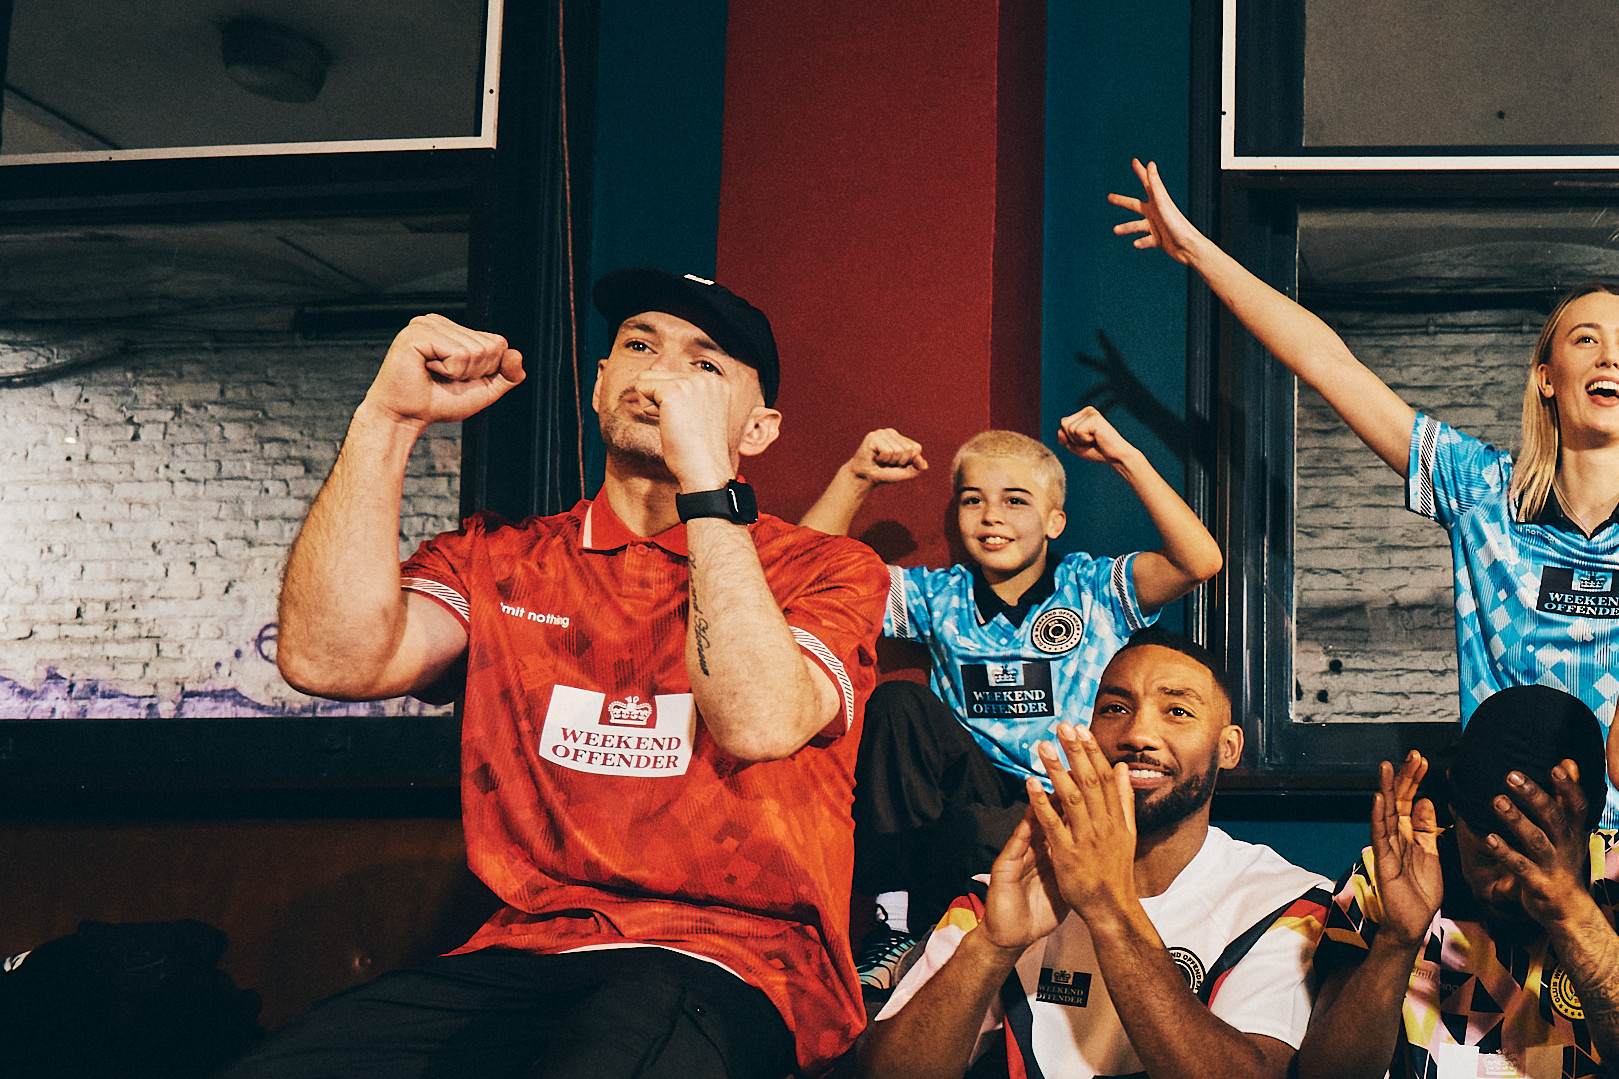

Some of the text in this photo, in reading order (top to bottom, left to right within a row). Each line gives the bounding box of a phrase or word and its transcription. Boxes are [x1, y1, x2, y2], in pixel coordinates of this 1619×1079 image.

[500, 602, 525, 618] mit
[972, 689, 1046, 702] WEEKEND
[972, 702, 1049, 714] OFFENDER
[561, 727, 682, 752] WEEKEND
[551, 744, 679, 770] OFFENDER
[1038, 984, 1084, 997] WEEKEND
